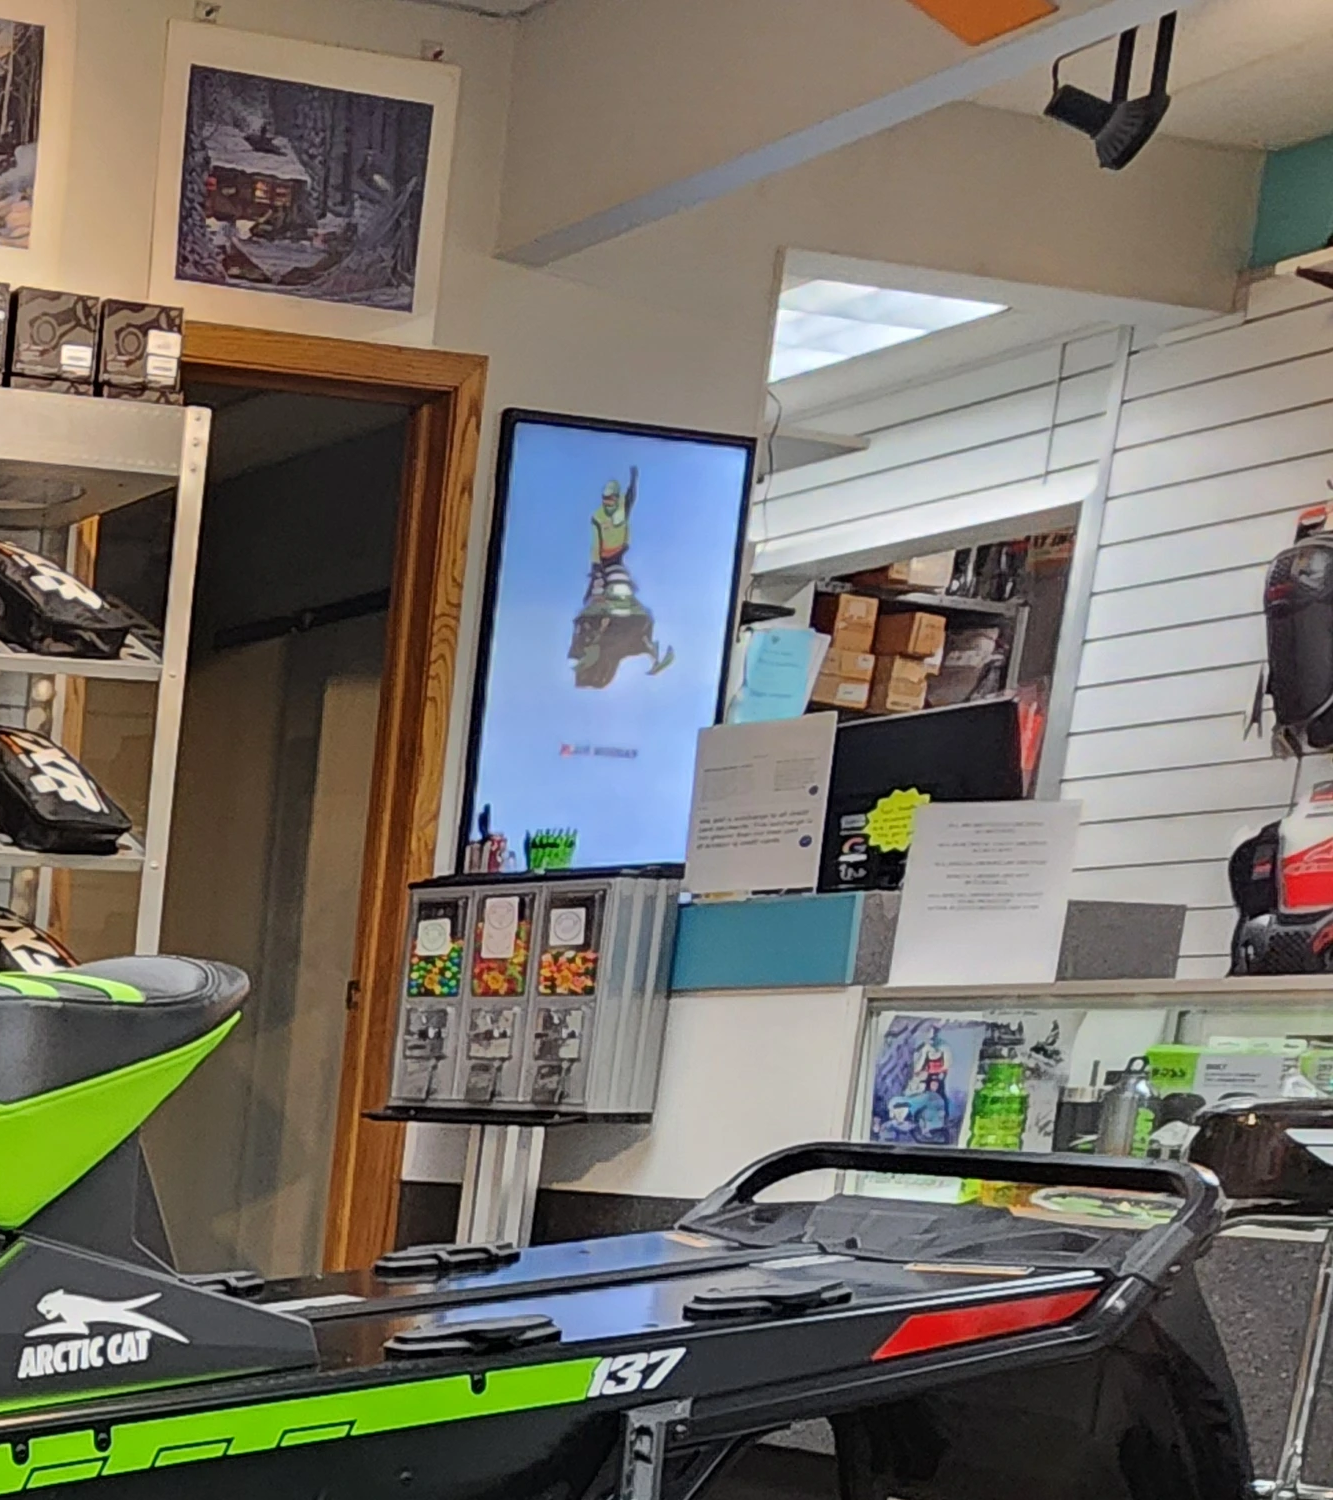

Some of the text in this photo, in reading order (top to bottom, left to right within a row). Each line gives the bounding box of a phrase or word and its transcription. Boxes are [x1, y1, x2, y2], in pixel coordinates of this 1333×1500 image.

[17, 1330, 151, 1380] ARCTIC CAT
[587, 1347, 687, 1398] 137
